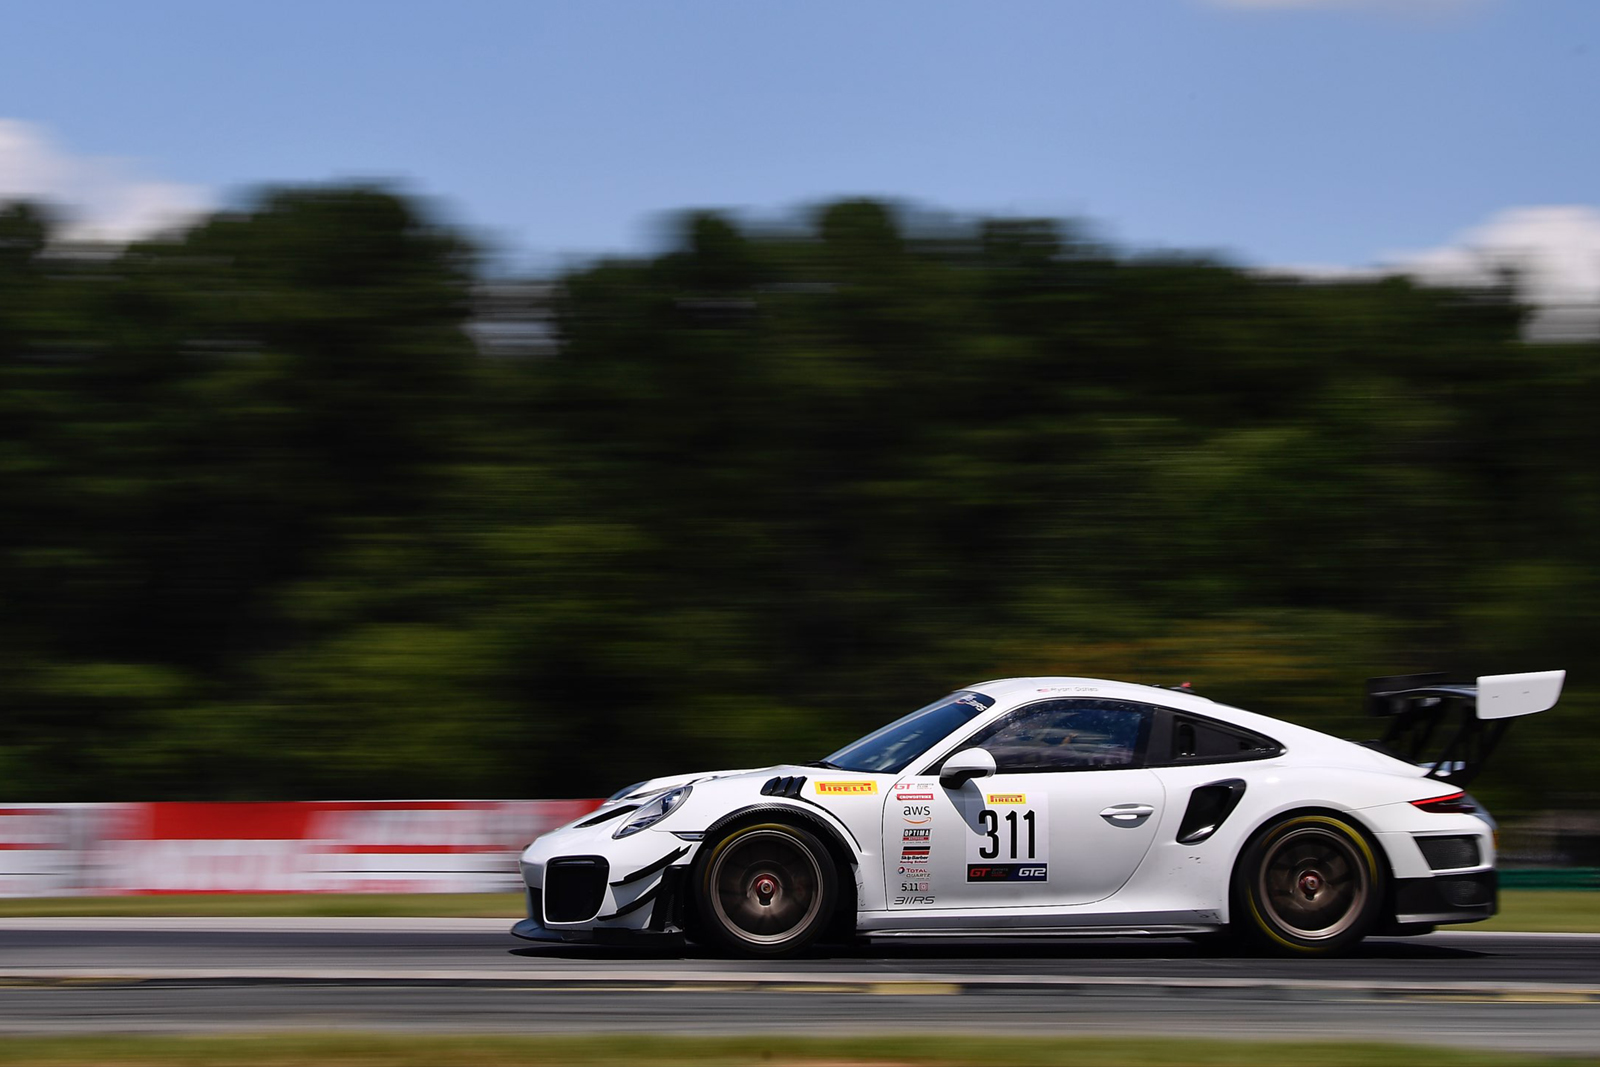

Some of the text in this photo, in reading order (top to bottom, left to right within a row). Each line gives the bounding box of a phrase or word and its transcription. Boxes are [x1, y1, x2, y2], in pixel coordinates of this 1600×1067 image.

[819, 782, 872, 792] PIRELLI
[990, 795, 1023, 803] PIRELLI
[903, 806, 931, 816] aws
[978, 809, 1036, 859] 311
[970, 868, 991, 877] GT
[1018, 868, 1046, 876] GT2
[901, 882, 918, 891] 5.11
